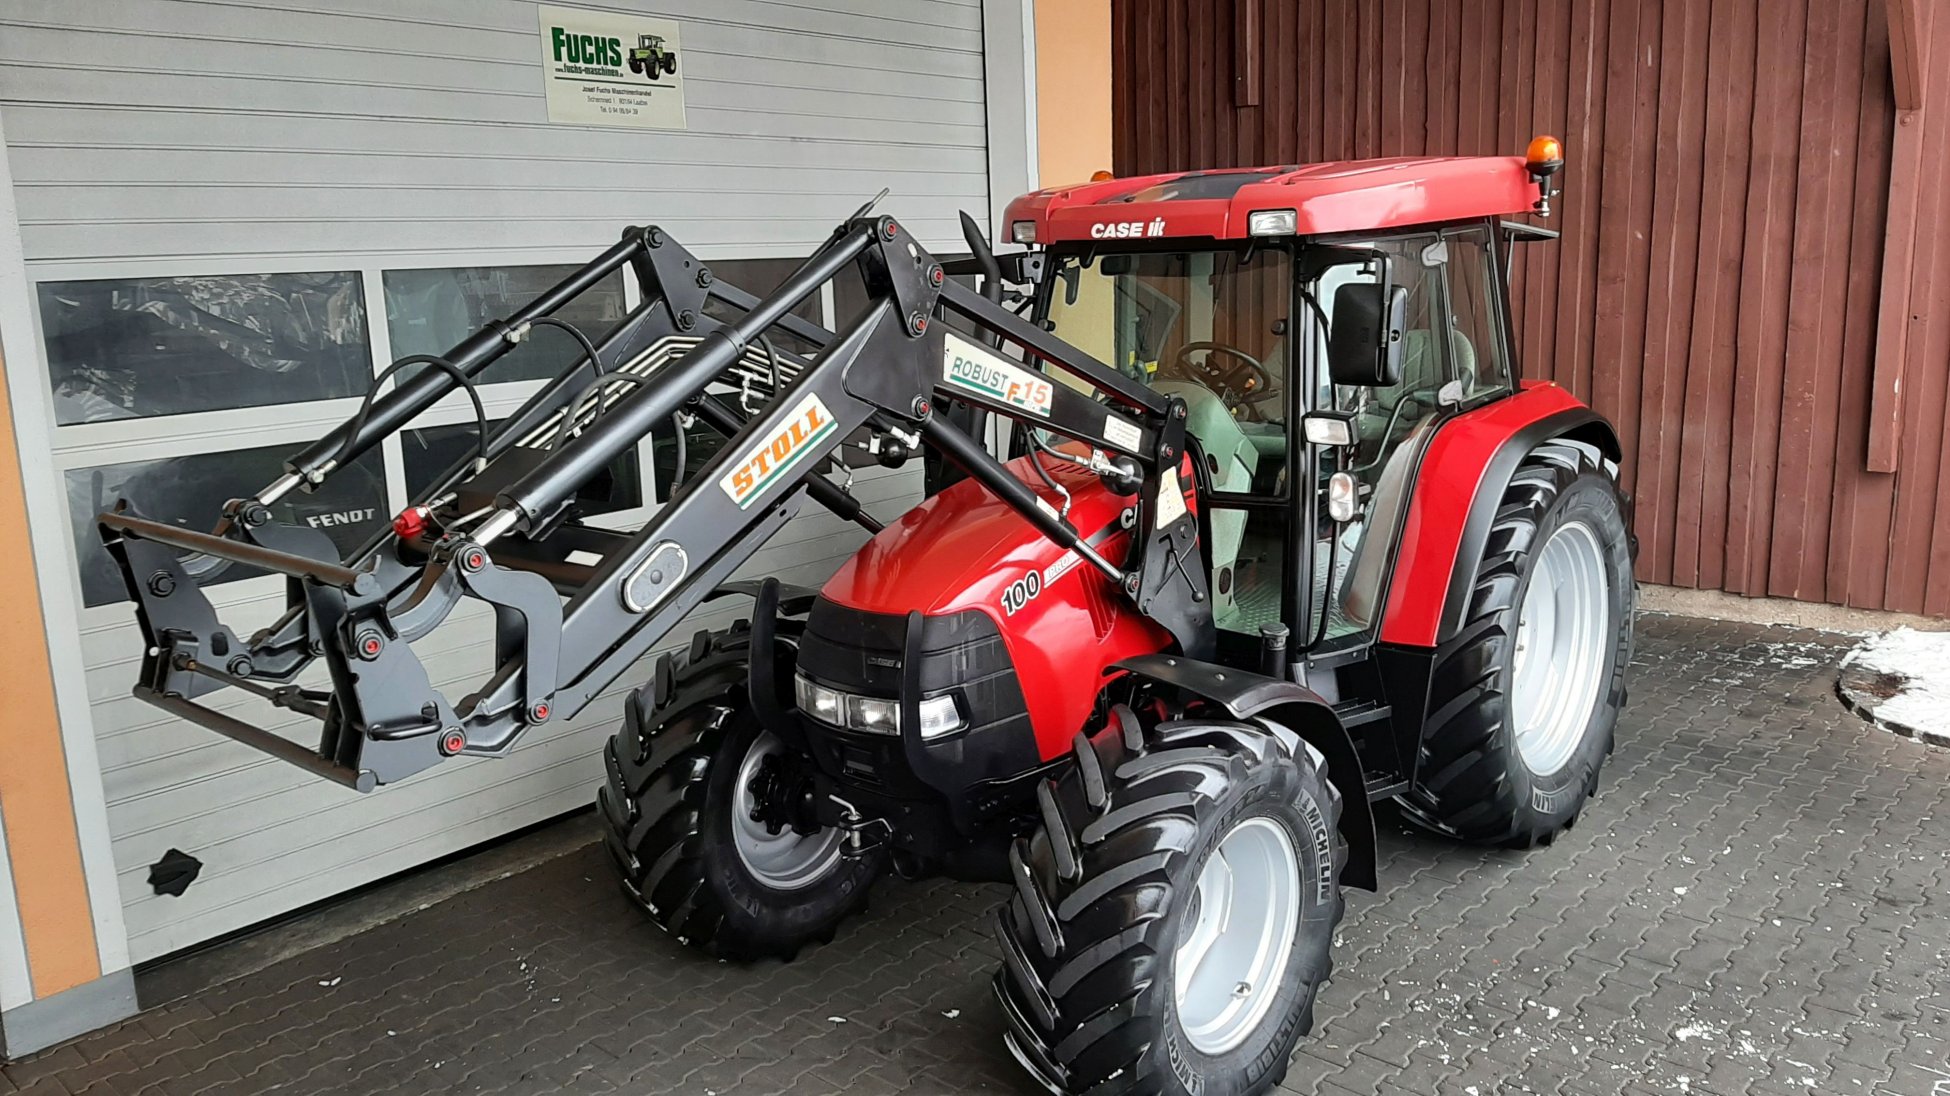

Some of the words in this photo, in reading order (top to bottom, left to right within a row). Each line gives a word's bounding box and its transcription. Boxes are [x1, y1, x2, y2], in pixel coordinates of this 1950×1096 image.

[551, 27, 622, 67] FUCHS
[1090, 222, 1145, 239] CASE
[951, 356, 1009, 391] ROBUST
[731, 405, 825, 498] STOLL
[306, 508, 376, 529] FENDT
[1002, 571, 1040, 616] 100
[1306, 805, 1332, 901] MICHELIN
